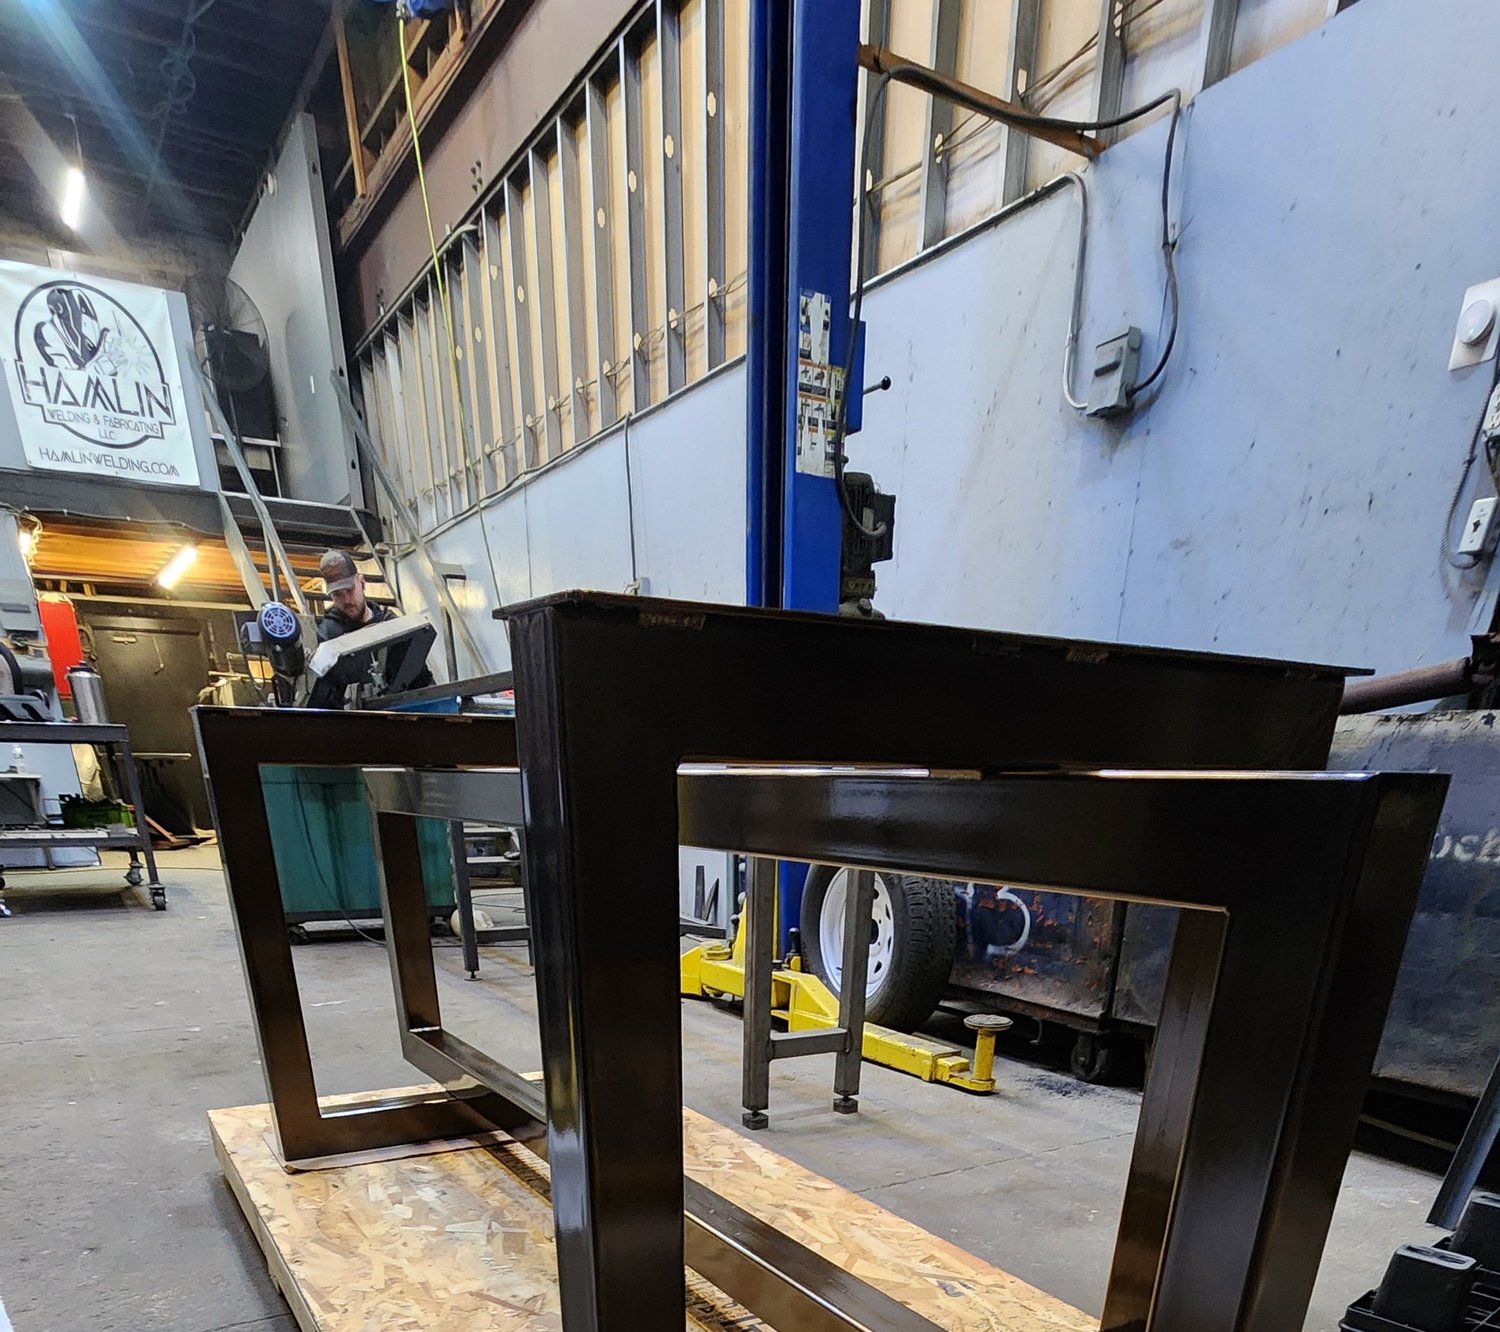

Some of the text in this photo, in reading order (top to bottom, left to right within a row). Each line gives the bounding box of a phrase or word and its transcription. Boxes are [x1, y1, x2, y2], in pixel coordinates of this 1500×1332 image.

[19, 364, 172, 419] HAMLIN
[47, 408, 160, 434] WELDING & FABRICATING
[98, 428, 117, 440] LLC
[39, 447, 181, 477] HAMLINWELDING.COM
